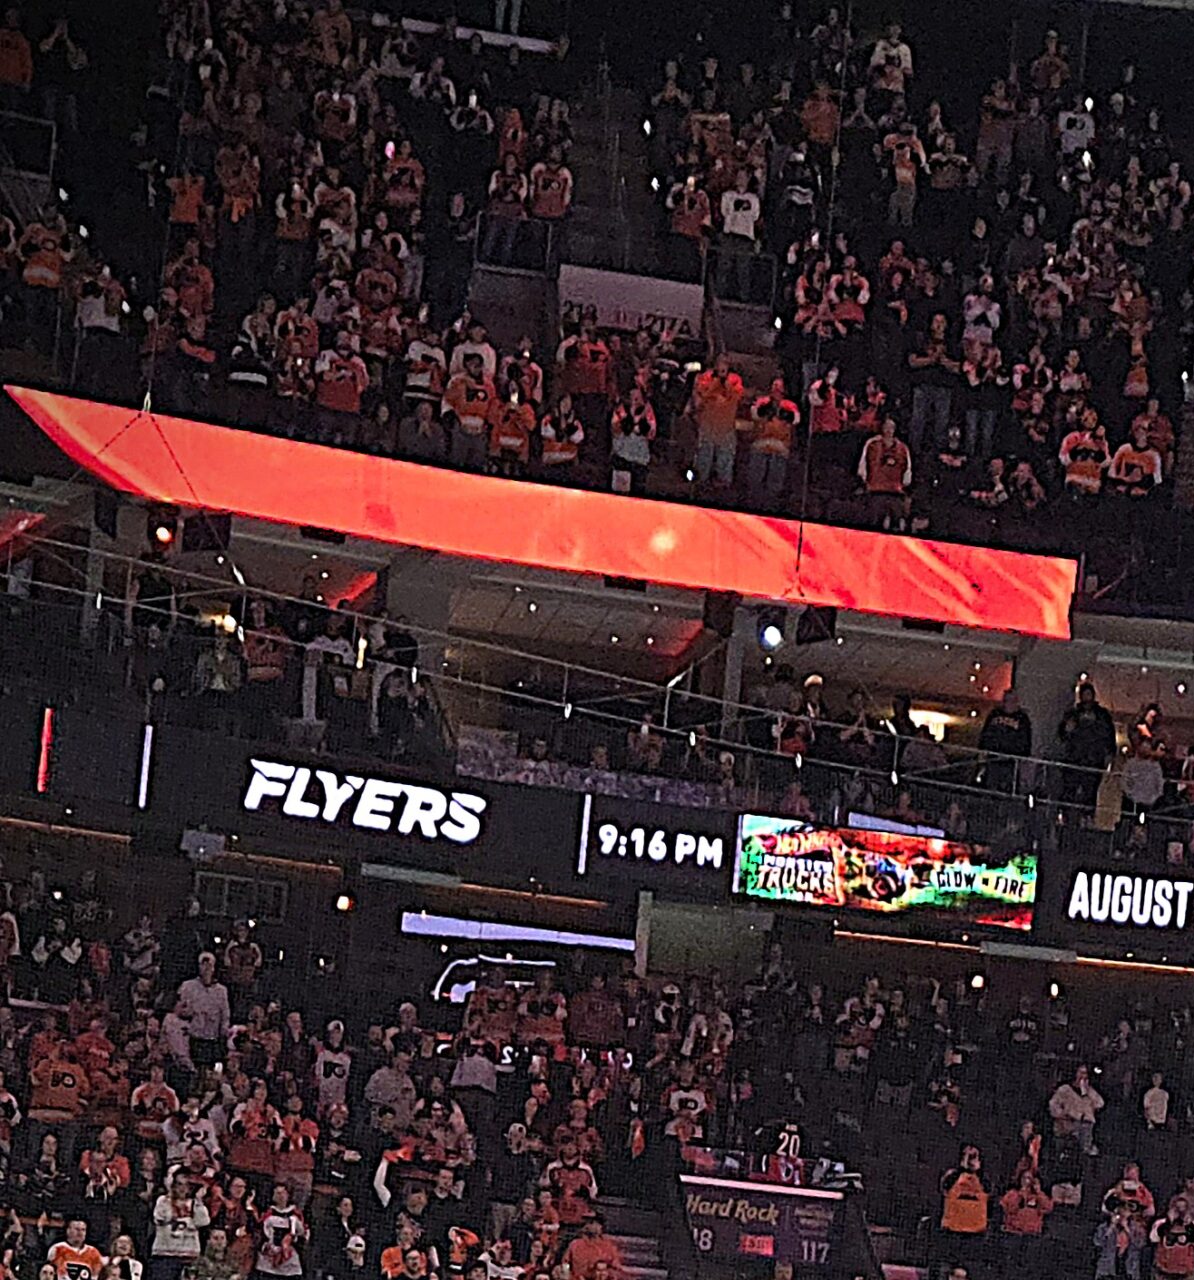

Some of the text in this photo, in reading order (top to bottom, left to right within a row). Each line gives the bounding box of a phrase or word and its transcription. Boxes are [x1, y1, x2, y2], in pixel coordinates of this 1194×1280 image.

[244, 759, 487, 844] FLYERS
[600, 823, 666, 862] 9:16
[675, 832, 724, 869] PM
[1068, 872, 1194, 928] AUGUST
[777, 1131, 801, 1158] 20
[686, 1193, 734, 1218] Hard
[735, 1198, 780, 1225] Rock
[801, 1240, 830, 1264] 117
